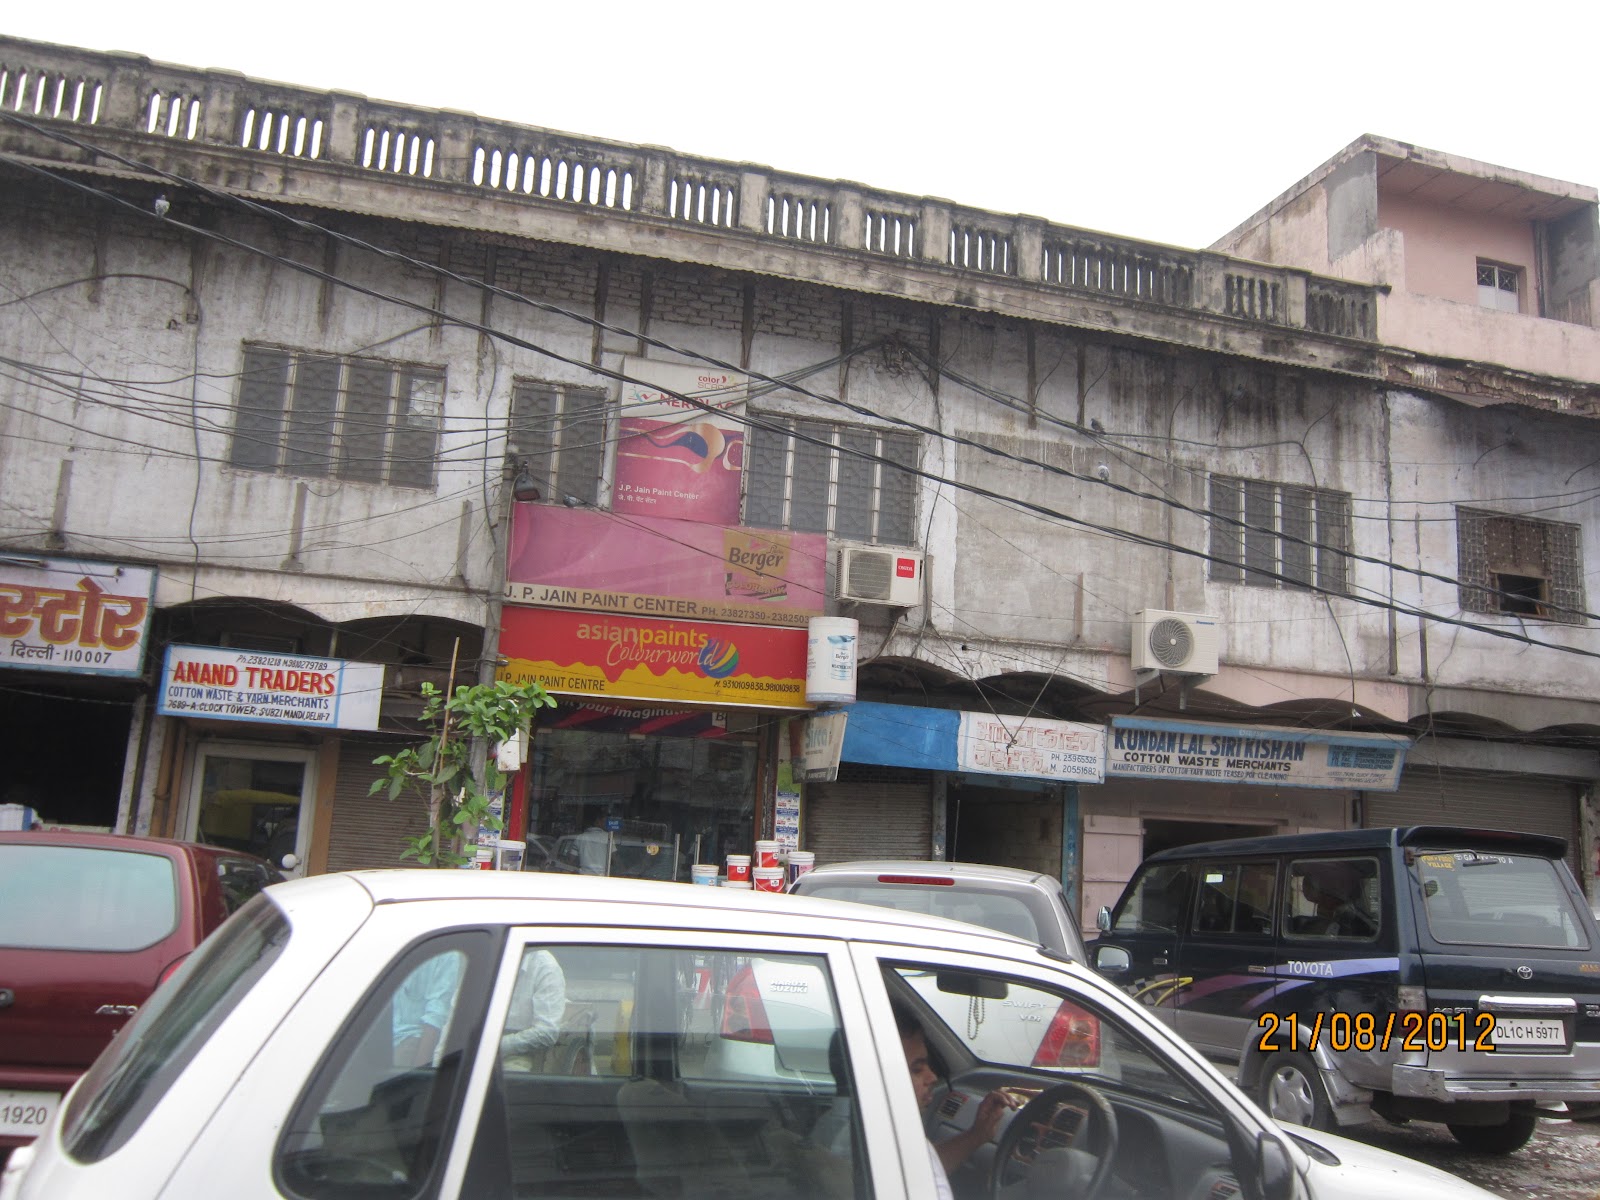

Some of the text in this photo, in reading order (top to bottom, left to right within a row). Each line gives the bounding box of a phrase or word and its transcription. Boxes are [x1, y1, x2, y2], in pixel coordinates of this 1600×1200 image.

[618, 484, 700, 500] J.P. Jain Paint Center
[730, 547, 784, 571] Berger
[504, 586, 517, 598] J.
[522, 587, 535, 600] P.
[540, 589, 577, 604] JAIN
[582, 592, 629, 608] PAINT
[634, 597, 697, 615] CENTER
[701, 607, 719, 616] PH.
[606, 641, 720, 667] Colourworld
[173, 660, 336, 697] ANAND TRADERS
[515, 673, 537, 686] JAIN
[539, 675, 566, 688] PAINT
[568, 677, 606, 692] CENTRE
[168, 686, 329, 711] COTTON WASTE & YARN MERCHANTS
[199, 703, 222, 713] CLOCK
[259, 706, 282, 718] SUBZI
[1113, 729, 1174, 753] KUNDAN
[1177, 732, 1208, 756] LAL
[1210, 735, 1240, 758] SIRI
[1242, 738, 1306, 761] KISHAN
[1051, 753, 1062, 762] PH.
[1124, 752, 1292, 771] COTTON WASTE MERCHANTS
[1050, 763, 1097, 776] M. 20551682
[1112, 763, 1157, 774] MANUFACTURERS
[1427, 861, 1453, 869] VILLAGE
[1288, 960, 1334, 976] TOYOTA
[1002, 1000, 1047, 1009] SWIFT
[1496, 1025, 1559, 1040] DL1C H 5977
[3, 1105, 48, 1125] 1920
